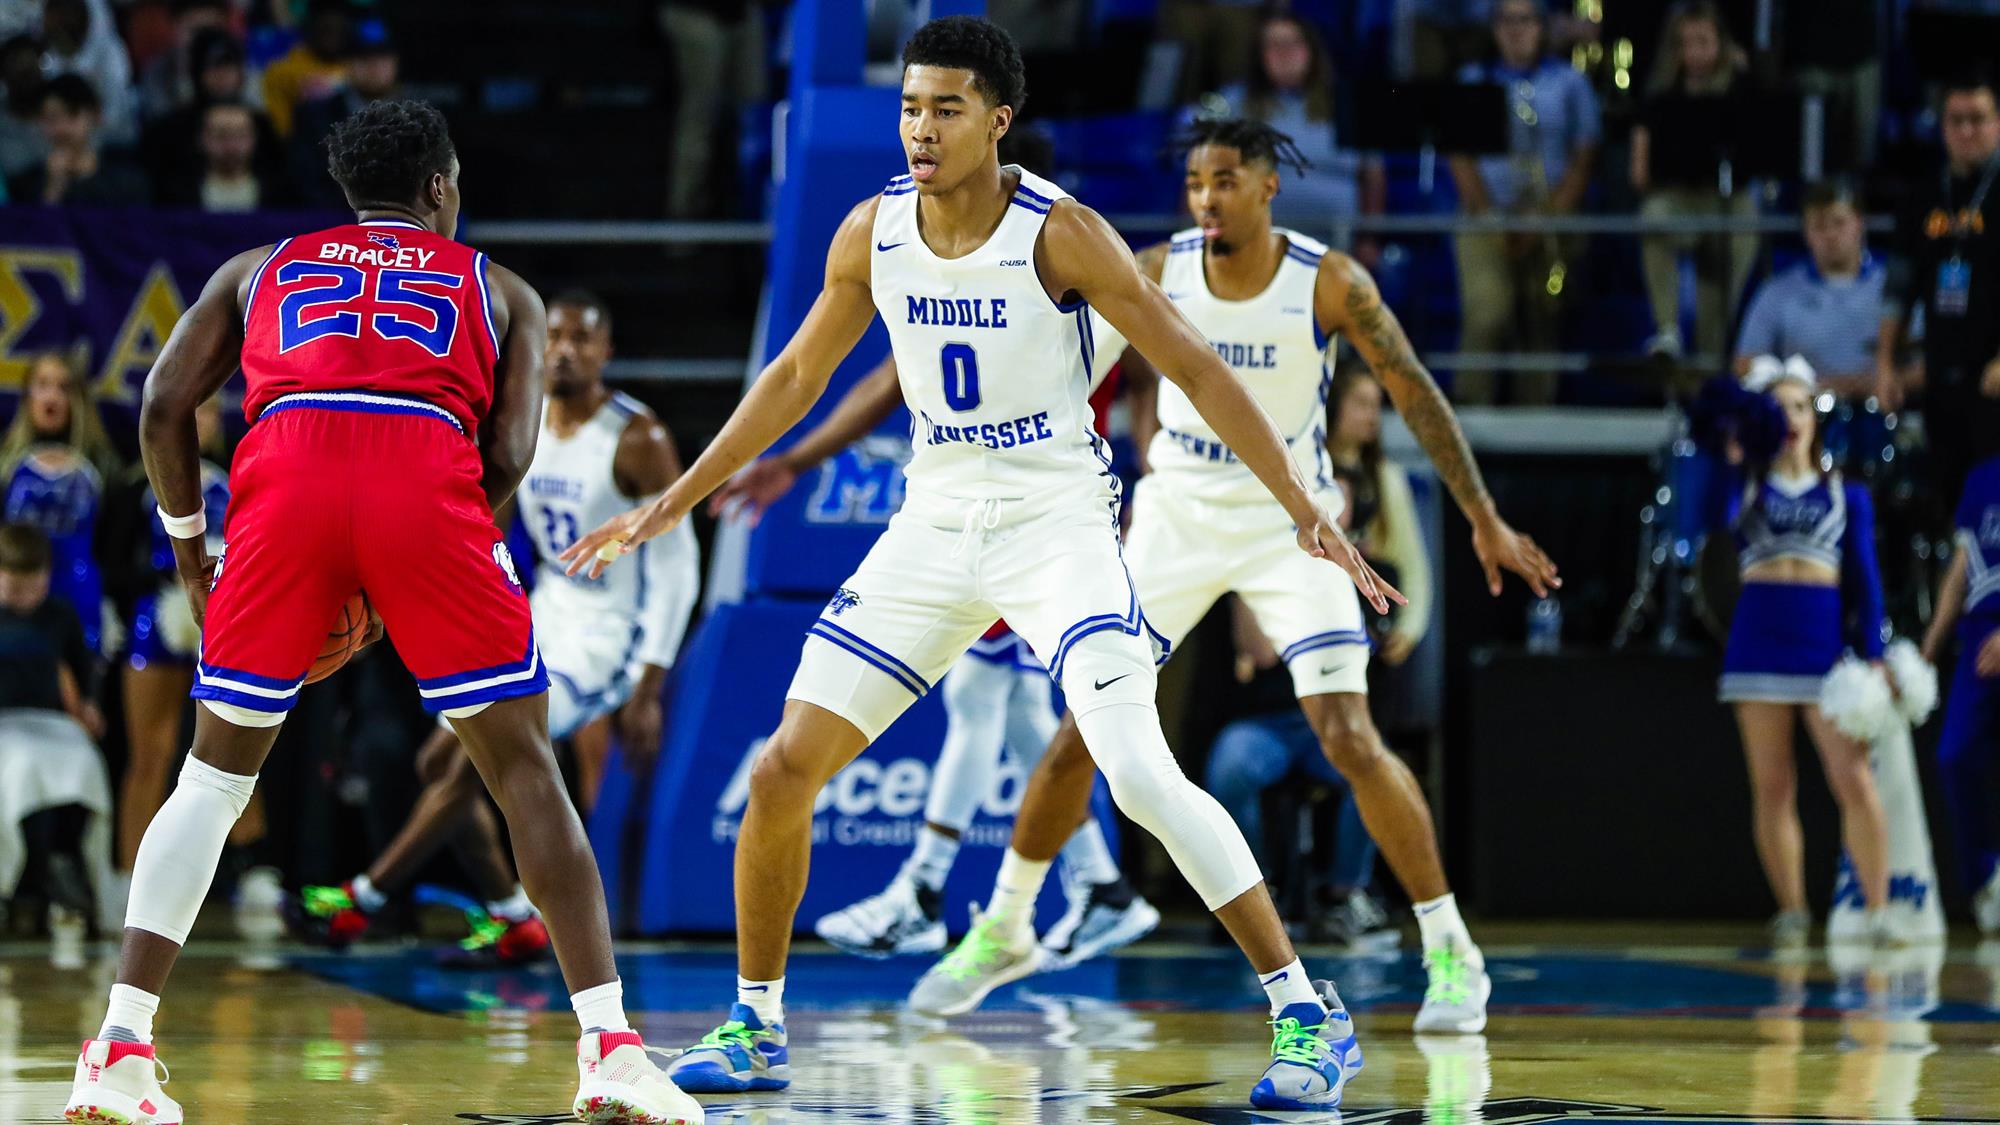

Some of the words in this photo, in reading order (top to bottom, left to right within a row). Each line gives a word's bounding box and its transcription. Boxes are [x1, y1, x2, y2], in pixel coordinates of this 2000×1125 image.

[318, 242, 435, 268] BRACEY
[276, 260, 464, 357] 25
[906, 295, 1007, 328] MIDDLE
[1210, 341, 1277, 369] DDLE
[939, 340, 983, 414] 0
[920, 409, 1053, 448] NNESSEE
